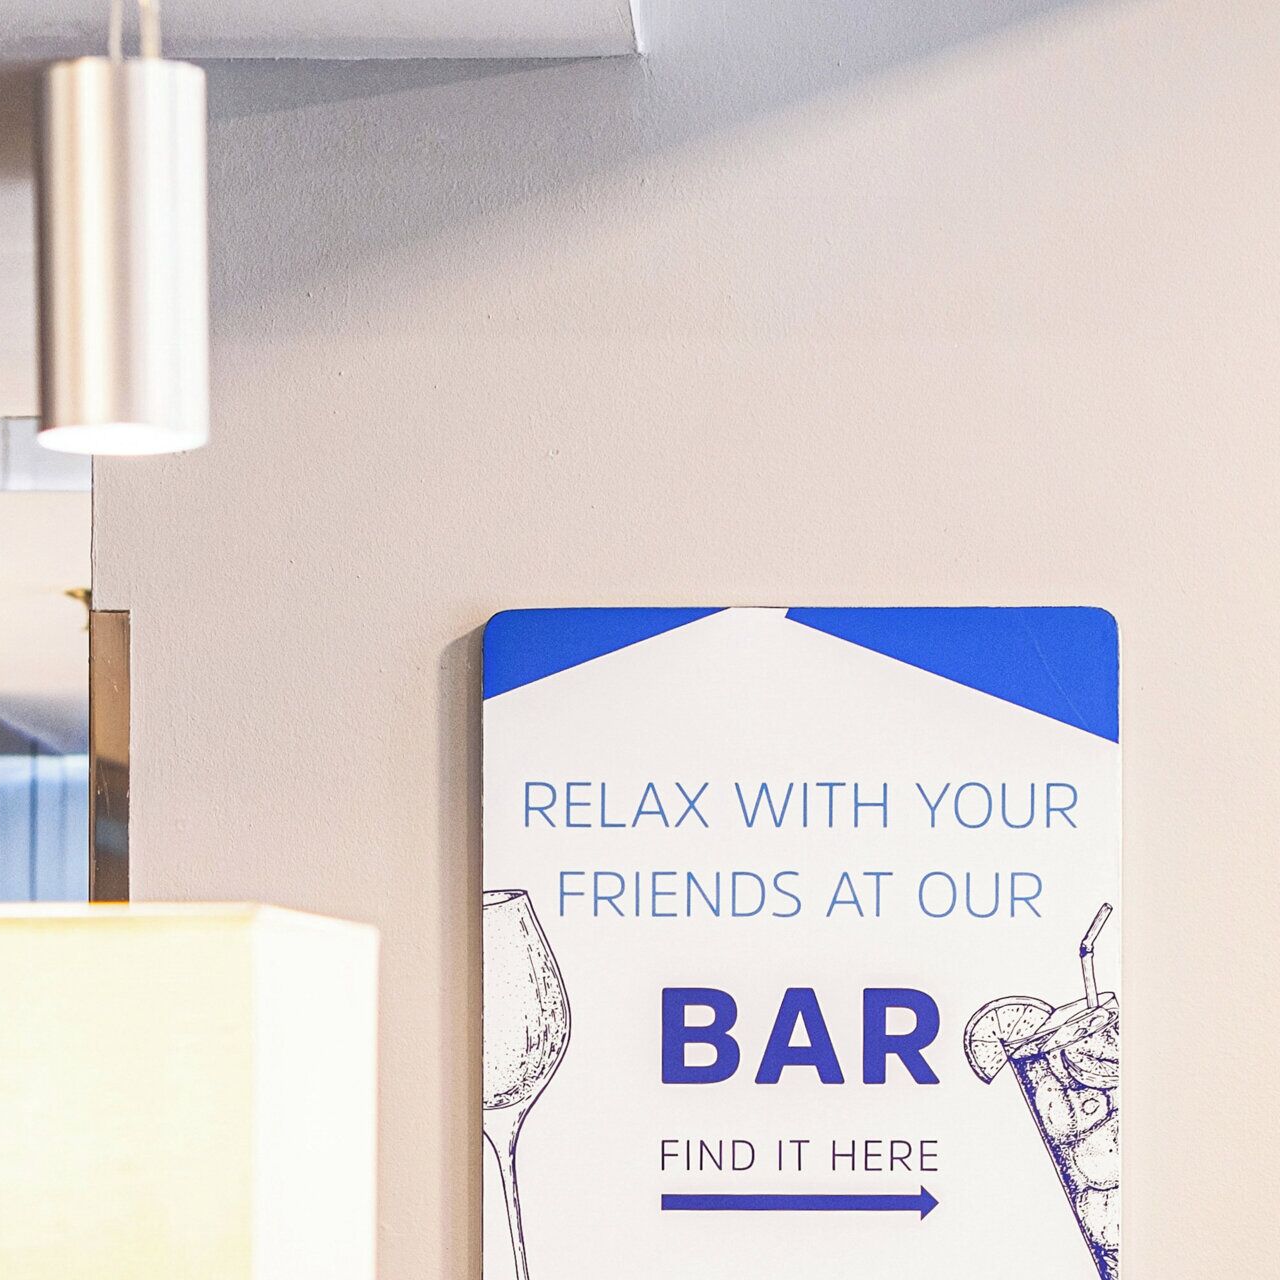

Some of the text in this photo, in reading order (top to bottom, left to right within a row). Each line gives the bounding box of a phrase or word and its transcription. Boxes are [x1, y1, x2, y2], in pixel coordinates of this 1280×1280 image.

[524, 781, 1078, 829] RELAX WITH YOUR
[559, 870, 1044, 919] FRIENDS AT OUR
[661, 985, 941, 1086] BAR
[660, 1139, 939, 1172] FIND IT HERE
